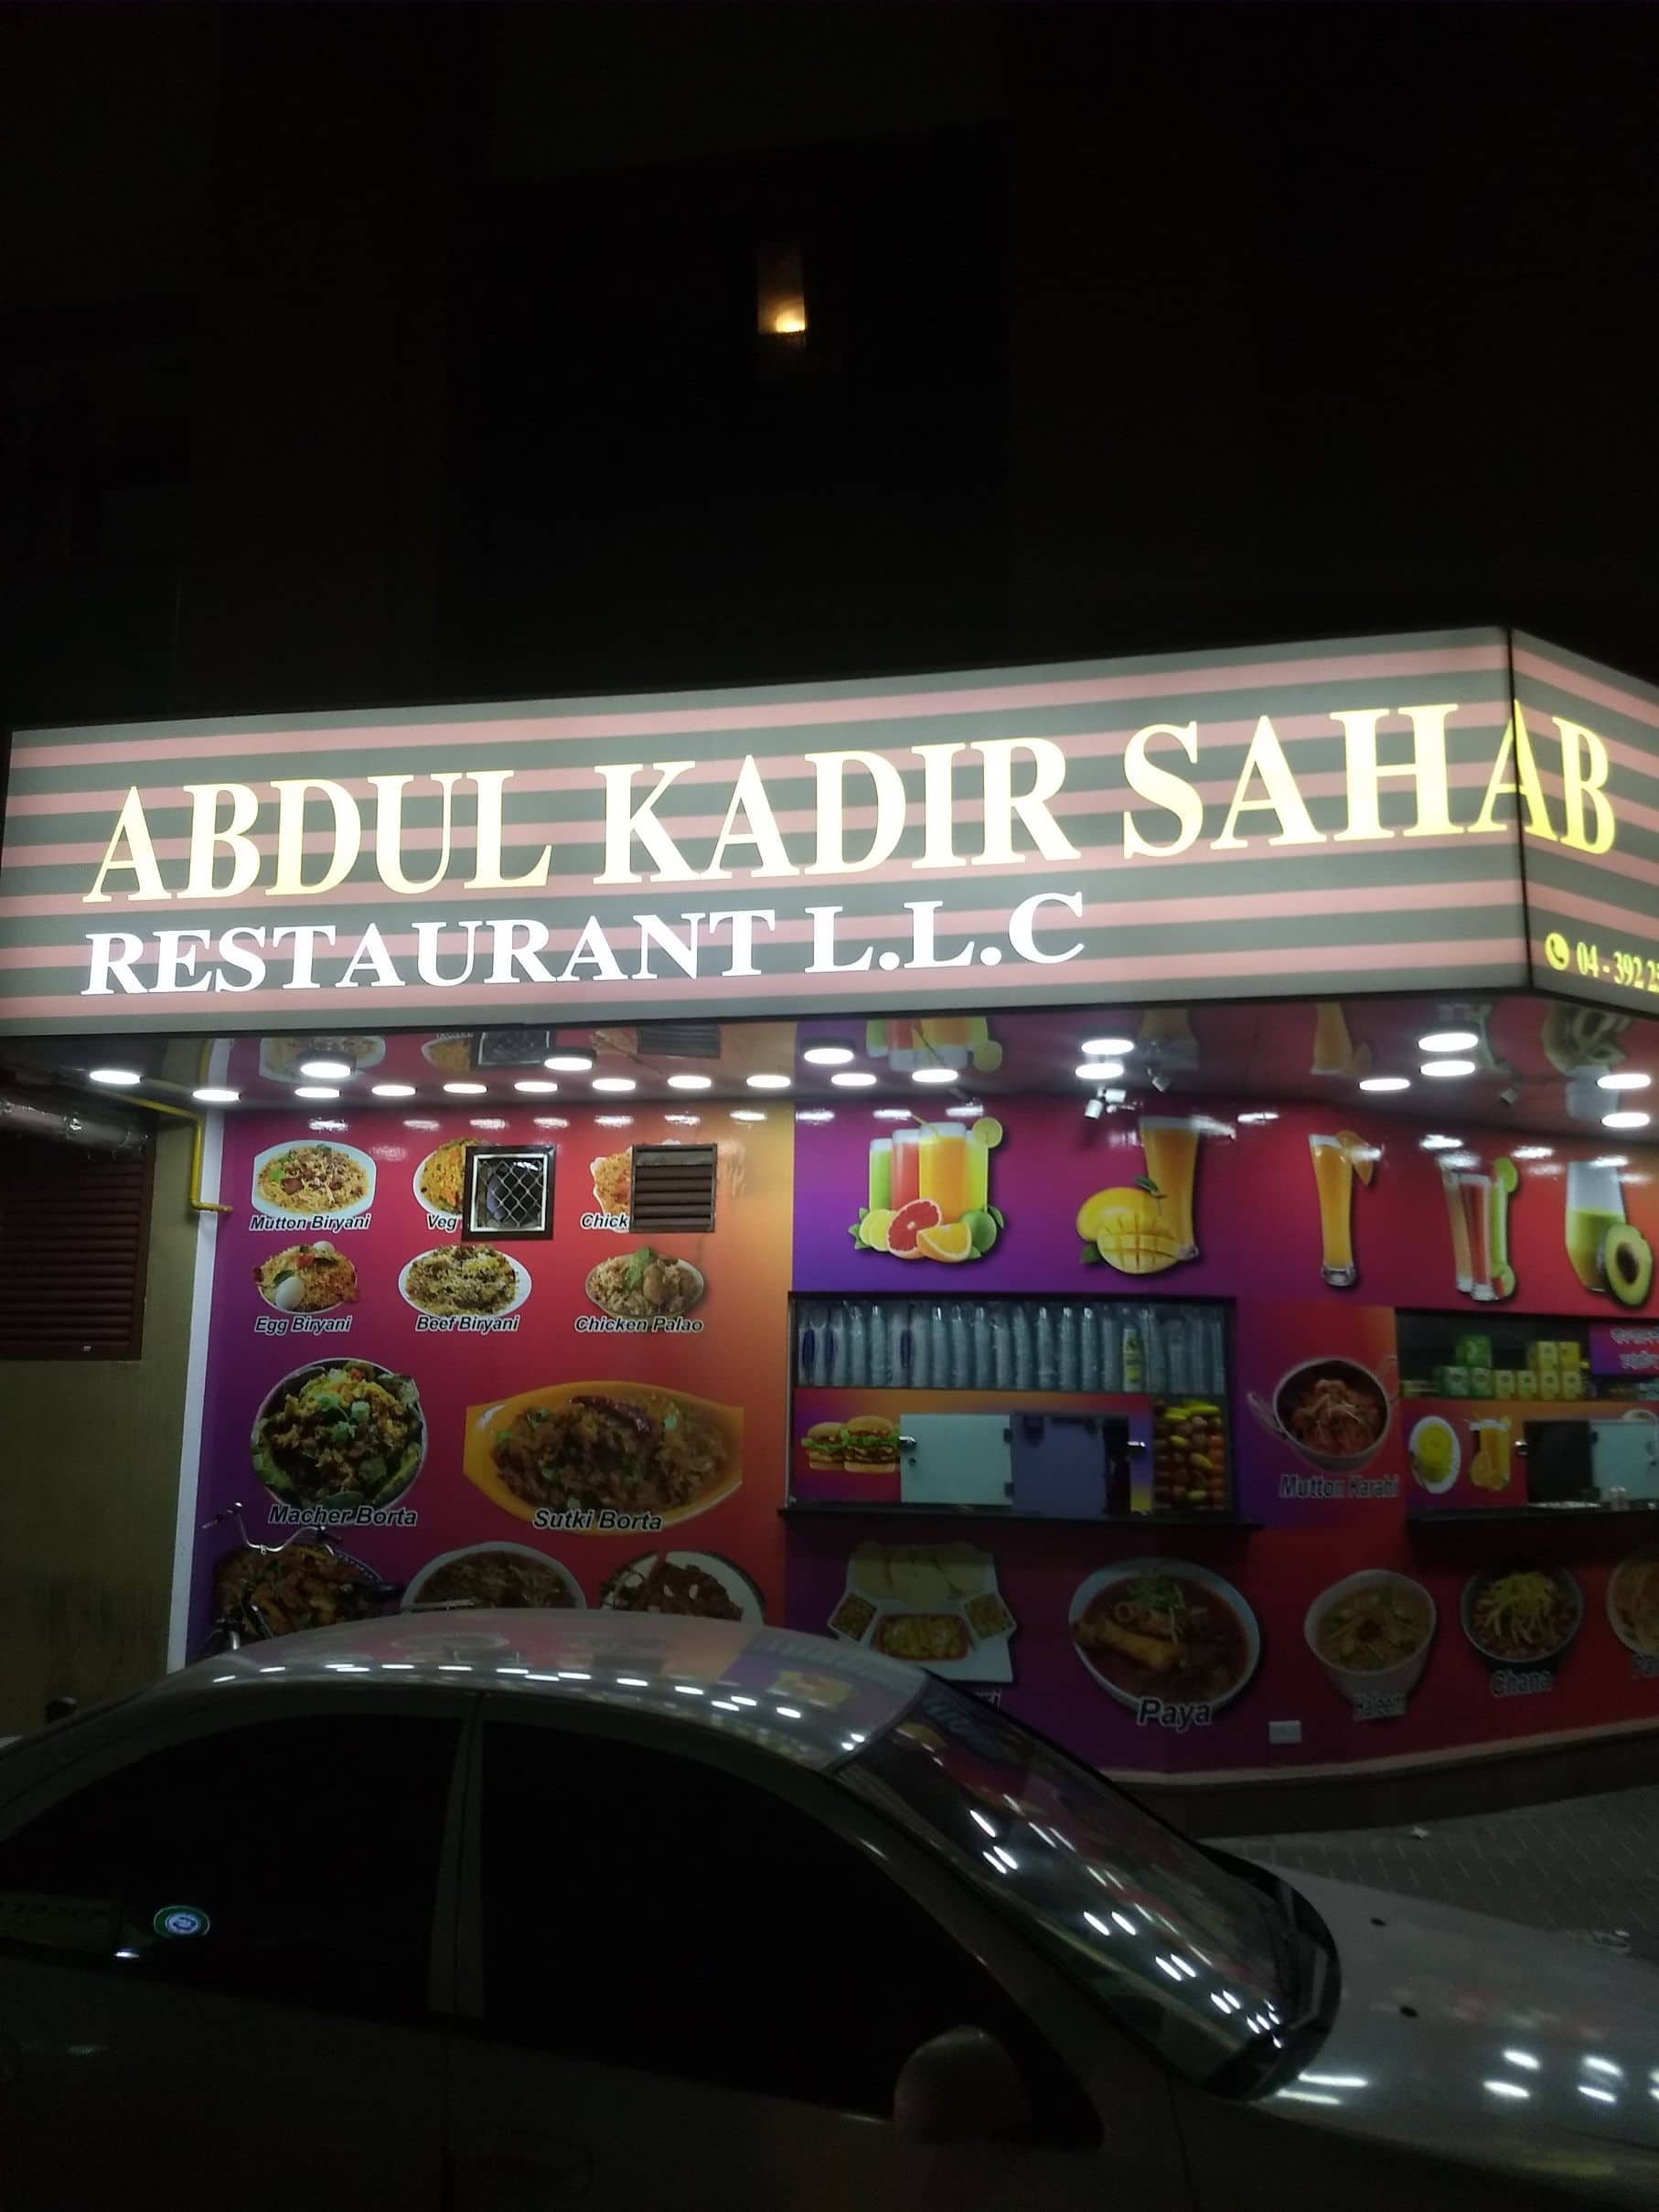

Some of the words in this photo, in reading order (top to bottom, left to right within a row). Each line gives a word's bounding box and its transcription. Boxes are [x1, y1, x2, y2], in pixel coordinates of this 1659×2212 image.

[82, 769, 552, 904] ABDUL
[592, 736, 1083, 887] KADIR
[1122, 700, 1617, 860] SAHAB
[80, 908, 776, 997] RESTAURANT
[804, 891, 1086, 975] L.L.C
[1577, 942, 1600, 978] 04
[1613, 951, 1644, 989] 392
[250, 1214, 307, 1231] Mutton
[310, 1213, 371, 1234] Biryani
[427, 1213, 458, 1233] Veg
[254, 1317, 288, 1336] Egg
[291, 1315, 353, 1335] Biryani
[415, 1316, 457, 1331] Beef
[458, 1315, 520, 1335] Biryani
[574, 1316, 648, 1332] Chicken
[651, 1317, 704, 1333] Palao
[1279, 1473, 1344, 1499] Mutton
[268, 1504, 352, 1526] Macher
[354, 1505, 418, 1528] Borta
[532, 1507, 597, 1530] Sutki
[599, 1509, 663, 1532] Borta
[1137, 1697, 1213, 1732] Paya
